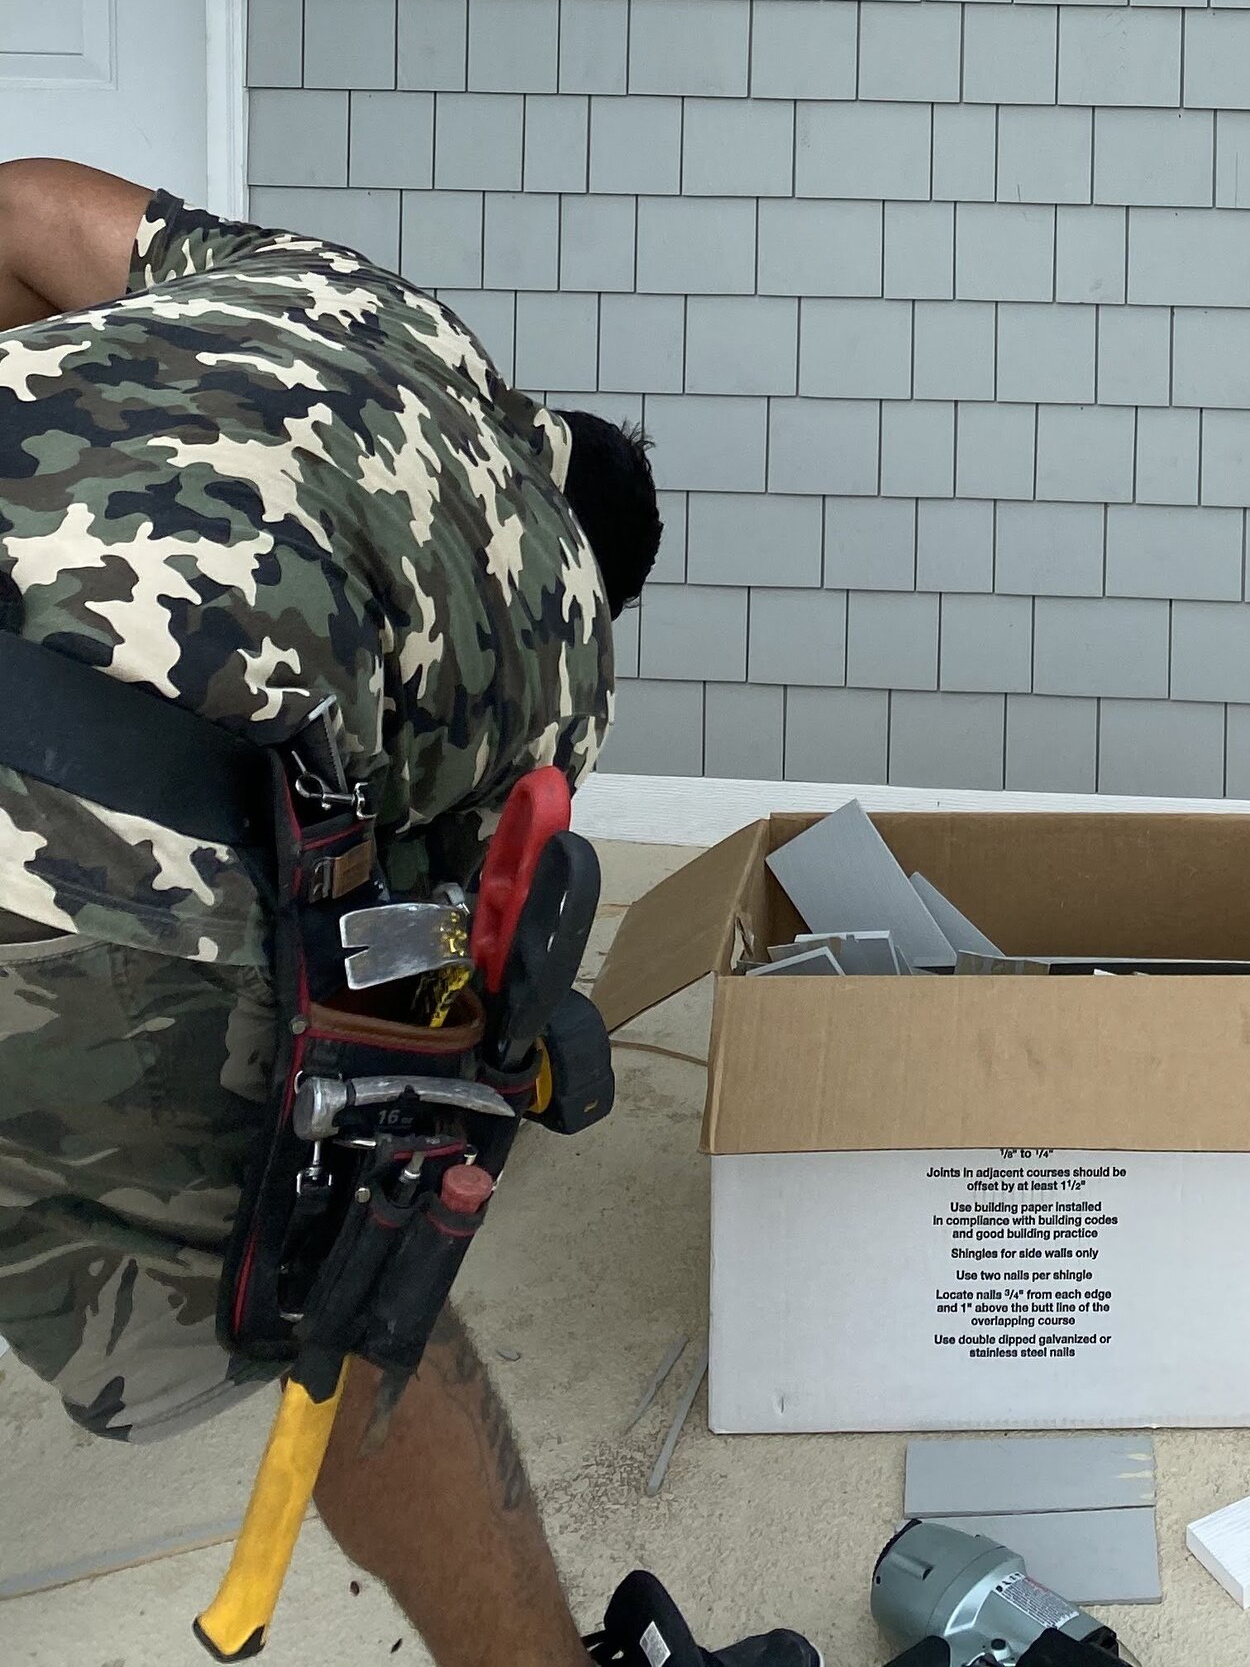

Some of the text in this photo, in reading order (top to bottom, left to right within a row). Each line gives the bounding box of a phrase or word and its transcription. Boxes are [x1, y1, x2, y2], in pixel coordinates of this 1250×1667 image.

[379, 1109, 400, 1124] 16
[1020, 1149, 1032, 1159] to
[926, 1166, 1127, 1181] Joints in adjacent courses should be
[966, 1180, 999, 1192] offset
[1001, 1180, 1015, 1193] by
[1016, 1181, 1029, 1192] at
[1030, 1180, 1059, 1192] least
[950, 1200, 1102, 1215] Use building paper installed
[932, 1213, 1119, 1228] in compliance with building codes
[952, 1227, 1099, 1242] and good building practice
[950, 1247, 1099, 1261] Shingles for side walls only
[956, 1269, 1093, 1283] Use two nails per shingle
[935, 1288, 974, 1300] Locate
[975, 1289, 1003, 1300] nails
[1026, 1289, 1053, 1300] from
[1054, 1288, 1082, 1300] each
[1084, 1288, 1112, 1302] edge
[936, 1301, 1110, 1314] and 1" above the butt line of the
[970, 1315, 1076, 1328] overlapping course
[934, 1333, 1112, 1347] Use double dipped galvanized or
[969, 1346, 1076, 1358] stainless steel nails
